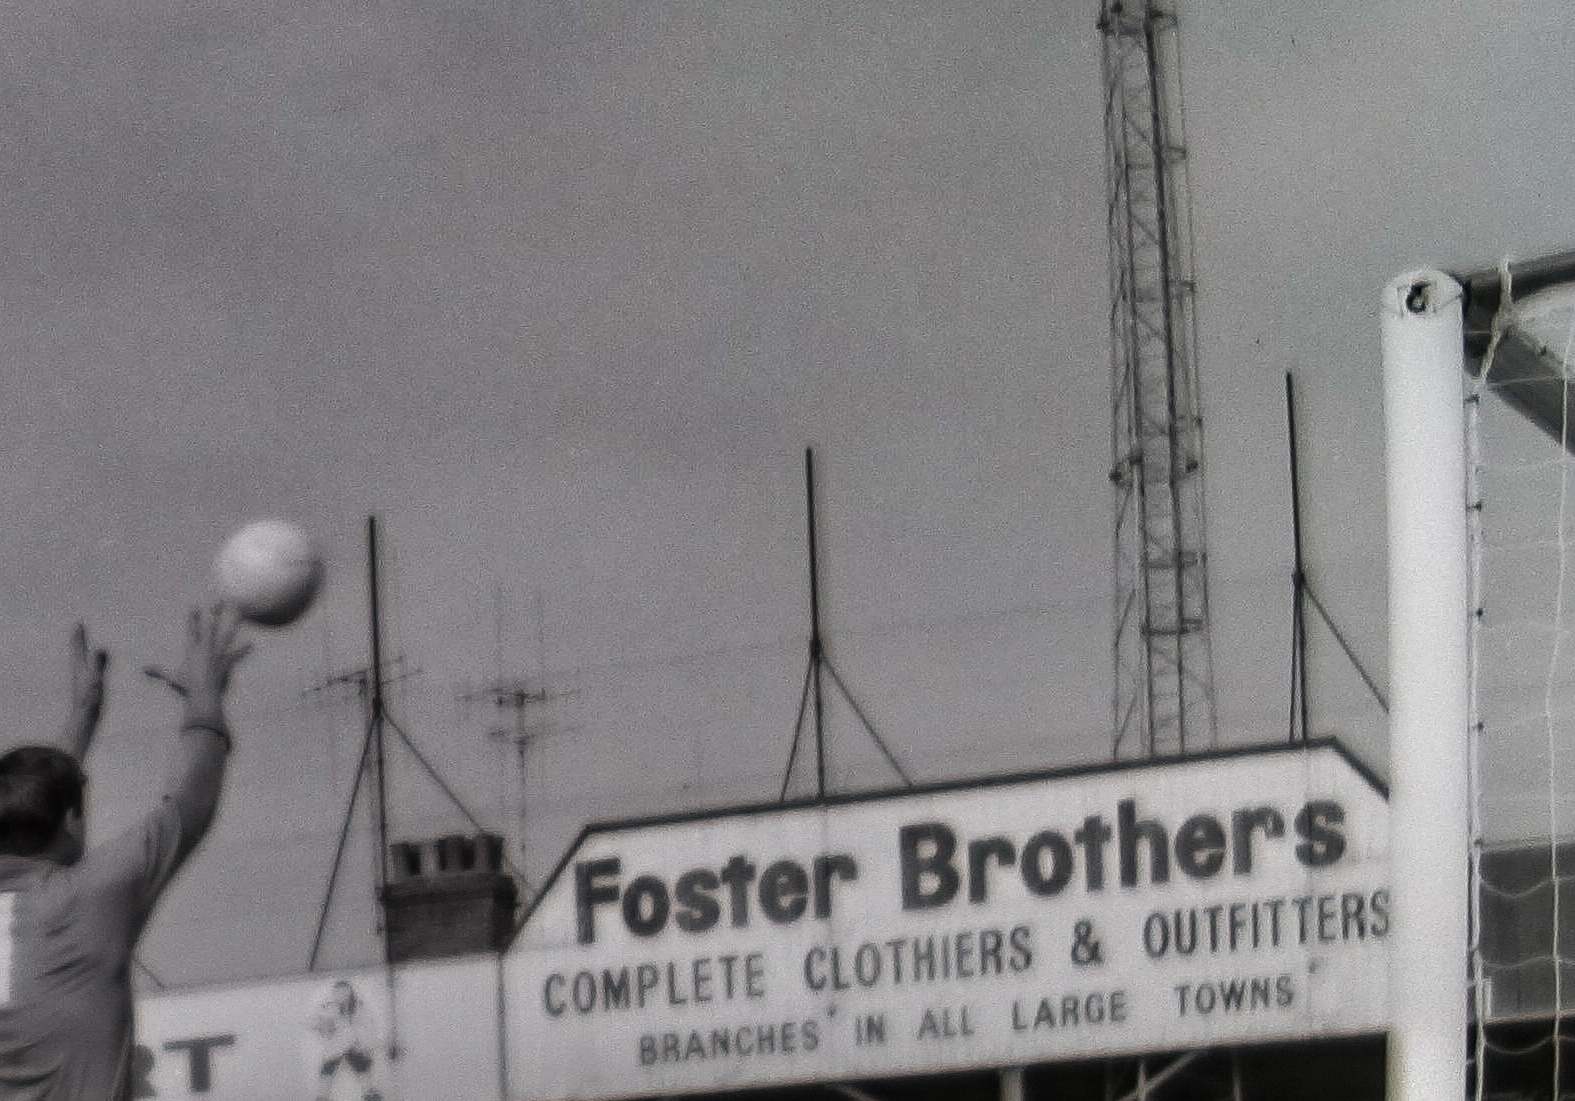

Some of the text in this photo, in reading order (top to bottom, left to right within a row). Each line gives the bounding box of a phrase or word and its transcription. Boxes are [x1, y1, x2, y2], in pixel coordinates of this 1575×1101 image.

[575, 797, 1348, 945] Foster Brothers
[543, 888, 1391, 1018] COMPLETE CLOTHIERS & OUTFITTERS
[639, 973, 1294, 1066] BRANCHES IN ALL LARGE TOWNS
